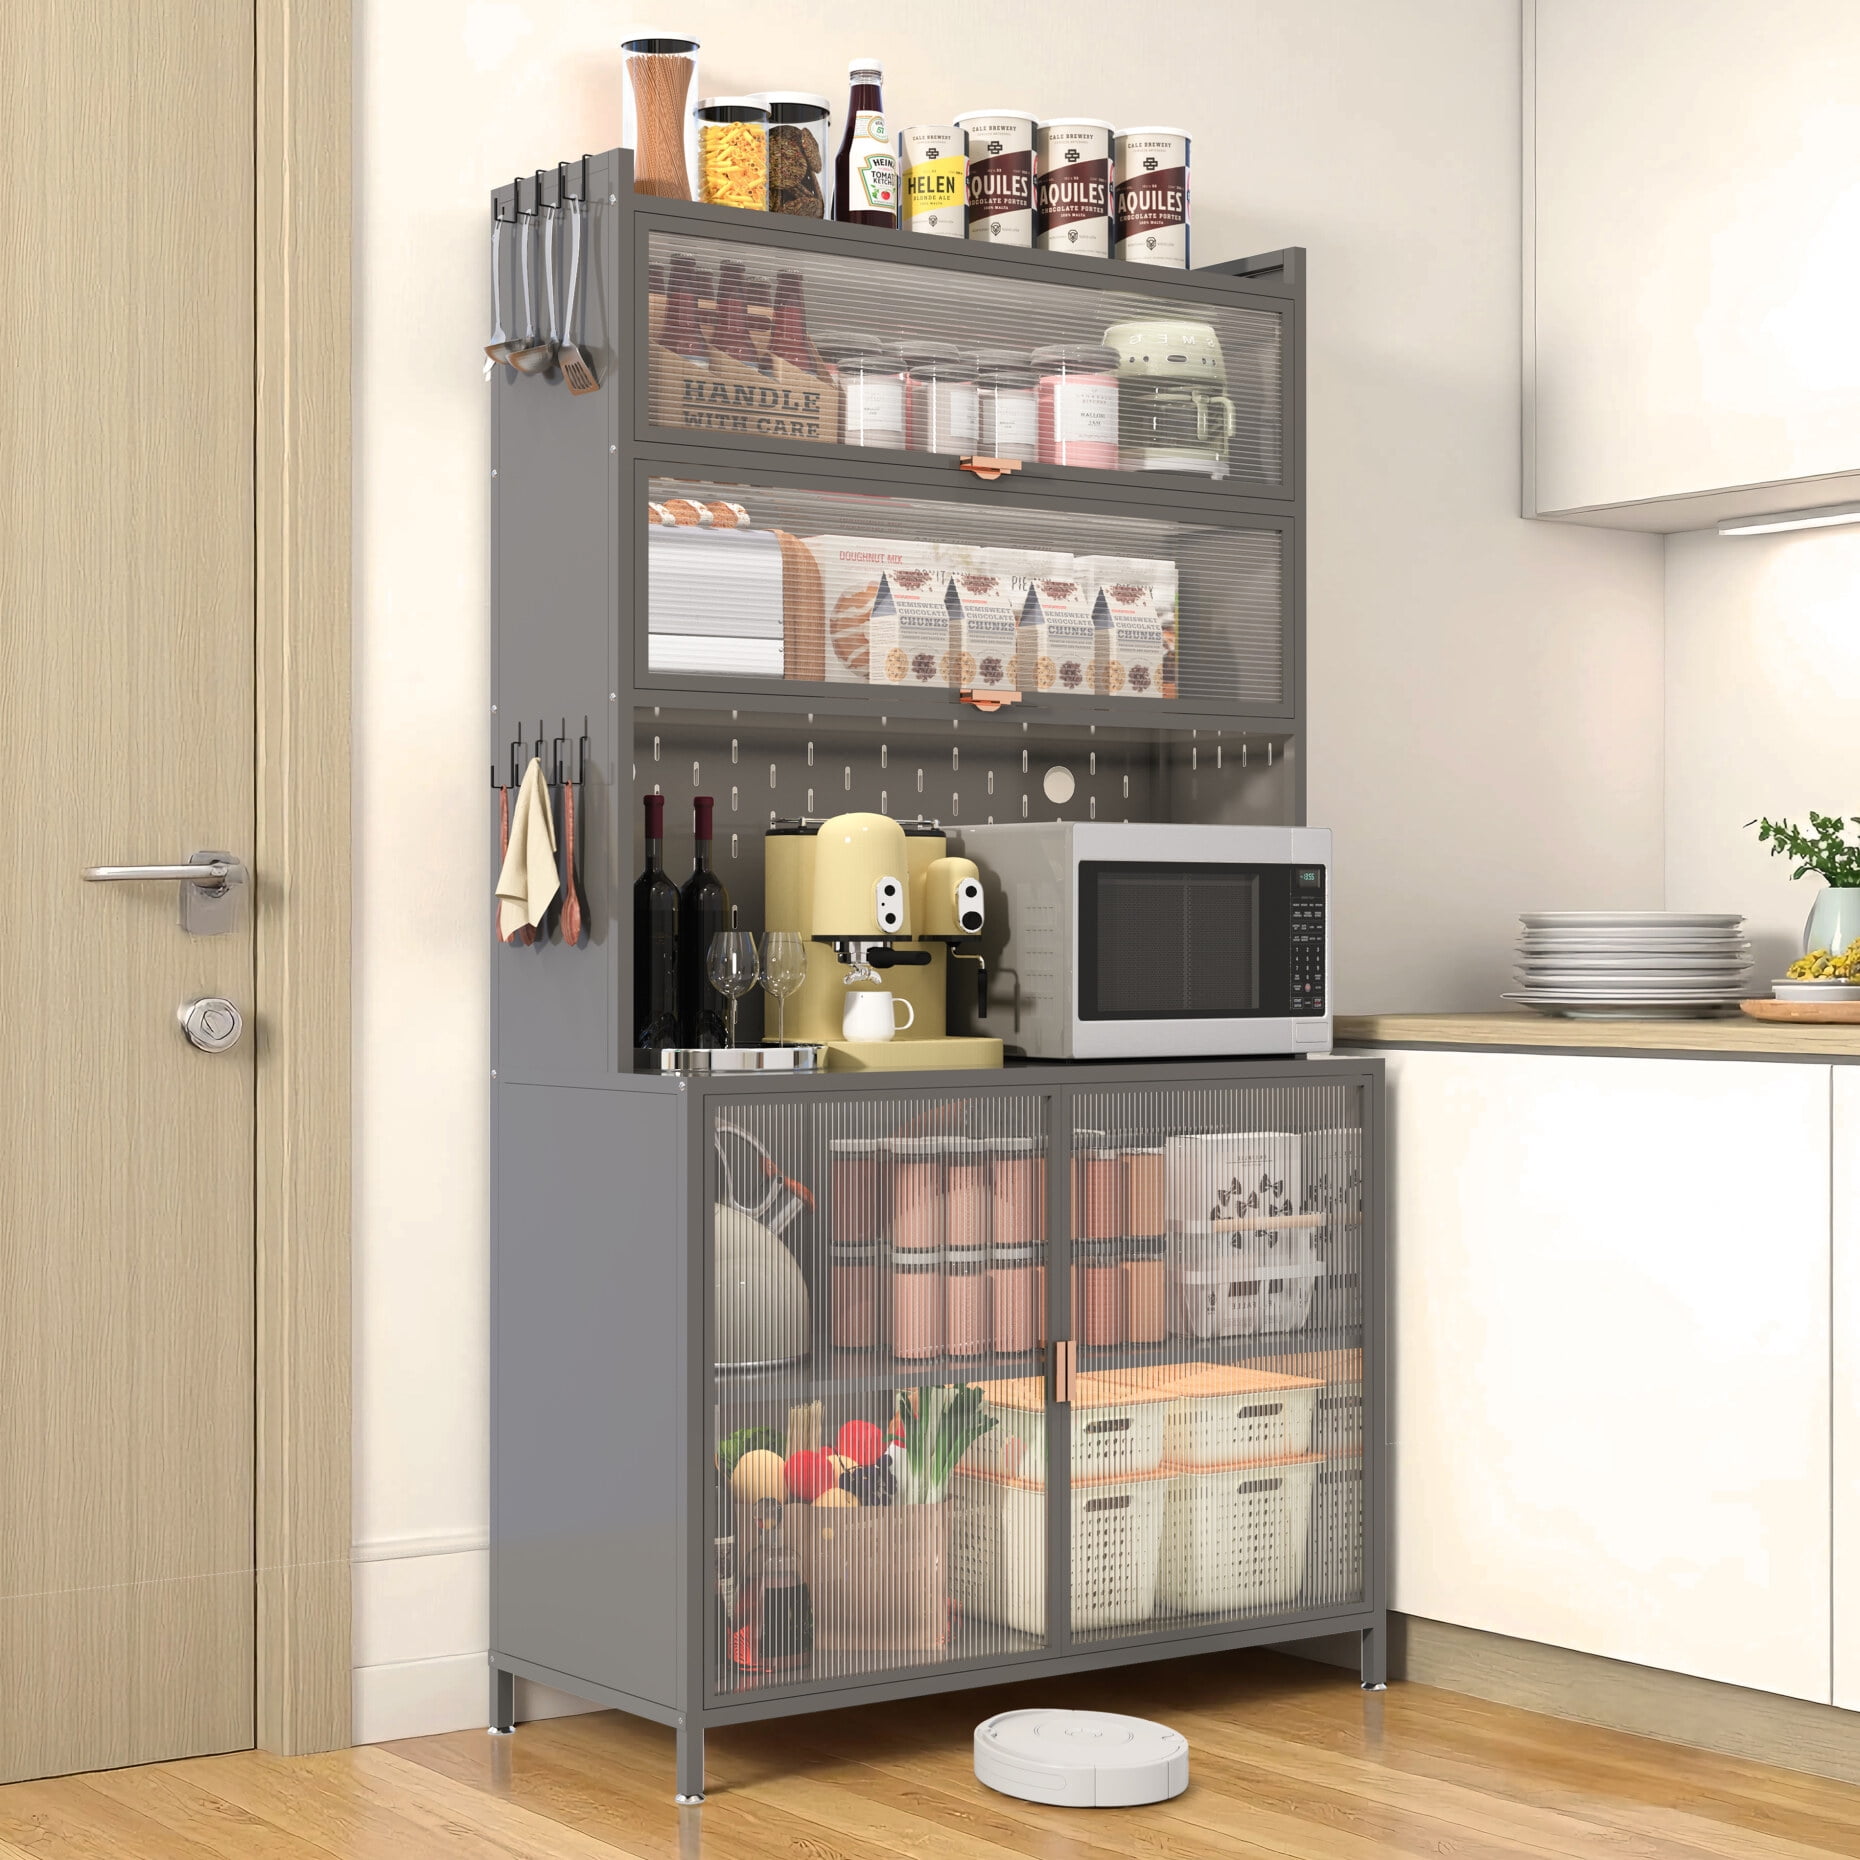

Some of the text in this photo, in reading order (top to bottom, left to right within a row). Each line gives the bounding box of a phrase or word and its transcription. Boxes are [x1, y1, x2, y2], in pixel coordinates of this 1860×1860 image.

[871, 170, 897, 180] TOMAT
[873, 178, 897, 187] KETCH
[908, 176, 955, 195] HELEN
[970, 174, 1028, 199] QUILES
[1040, 182, 1105, 206] AQUILES
[1004, 198, 1028, 206] PORTER
[1118, 190, 1183, 214] AQUILES
[1042, 205, 1104, 214] CHOCOLATE PORTER
[1120, 213, 1182, 222] CHOCOLATE PORTER
[682, 379, 821, 412] HANDLE
[682, 410, 820, 438] WITH CARE
[839, 550, 903, 565] DOUGHNUT MIX
[1012, 576, 1028, 591] PIE
[896, 602, 945, 610] SEMISWEET
[964, 606, 1012, 614] SEMISWEET
[898, 608, 947, 617] CHOCOLATE
[966, 612, 1014, 621] CHOCOLATE
[1044, 610, 1090, 619] SEMISWEET
[900, 616, 948, 628] CHUNKS
[1046, 618, 1093, 626] CHOCOLATE
[1114, 616, 1158, 624] SEMISWEET
[968, 620, 1015, 632] CHUNKS
[1048, 626, 1094, 636] CHUNKS
[1116, 622, 1161, 631] CHOCOLATE
[1118, 630, 1162, 640] CHUNKS
